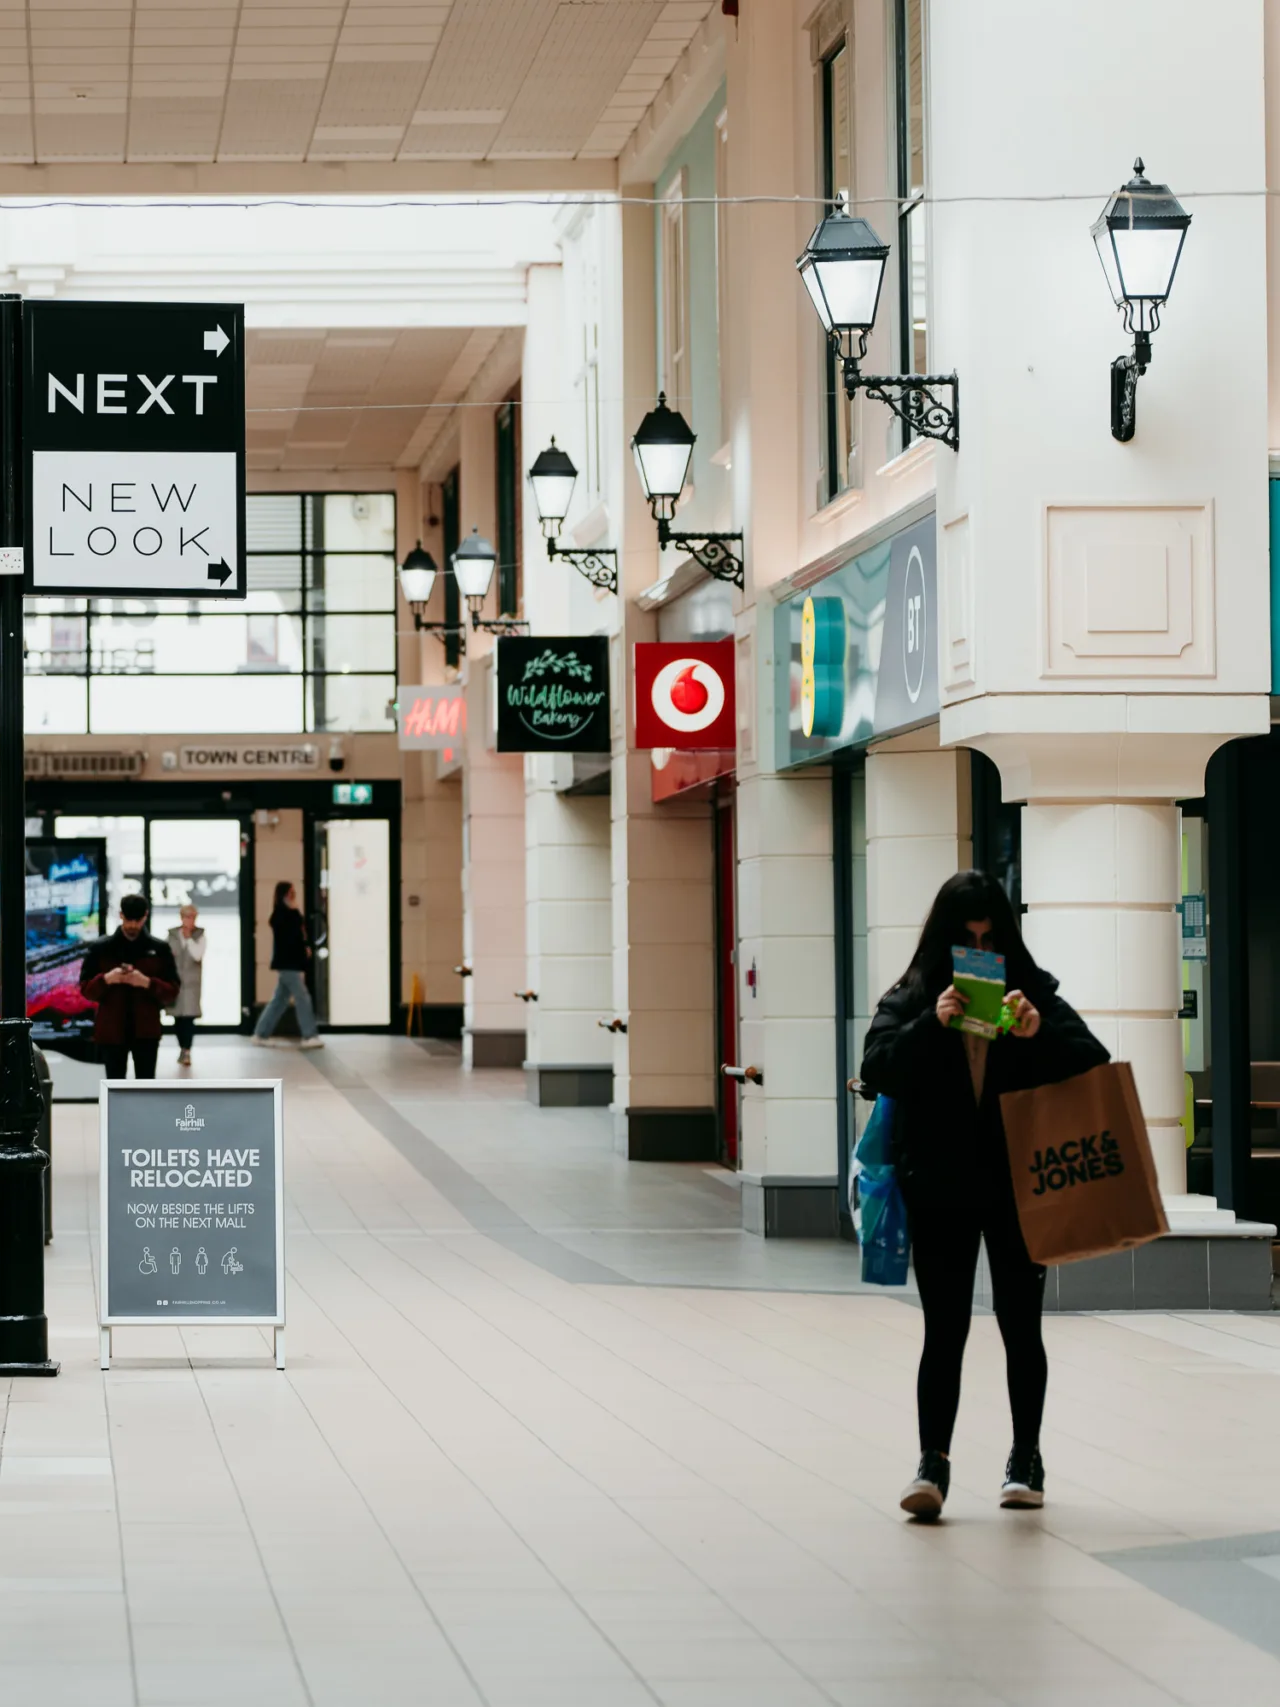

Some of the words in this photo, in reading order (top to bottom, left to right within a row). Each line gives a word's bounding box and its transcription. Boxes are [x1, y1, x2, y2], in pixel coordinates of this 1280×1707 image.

[48, 372, 218, 416] NEXT
[62, 483, 198, 513] NEW
[49, 526, 211, 557] LOOK
[907, 595, 921, 654] BT
[507, 684, 605, 710] Wildflower
[404, 697, 463, 737] H&M
[533, 709, 582, 729] Bakery
[186, 750, 238, 764] TOWN
[243, 750, 314, 764] CENTRE
[175, 1118, 205, 1128] Fairhill
[122, 1149, 199, 1168] TOILETS
[207, 1149, 260, 1167] HAVE
[130, 1169, 253, 1188] RELOCATED
[1032, 1152, 1125, 1196] JONES
[127, 1203, 158, 1215] NOW
[162, 1203, 201, 1215] BESIDE
[204, 1203, 225, 1215] THE
[228, 1203, 255, 1215] LIFTS
[135, 1217, 156, 1229] ON
[159, 1217, 180, 1229] THE
[183, 1217, 212, 1229] NEXT
[215, 1217, 247, 1229] MALL
